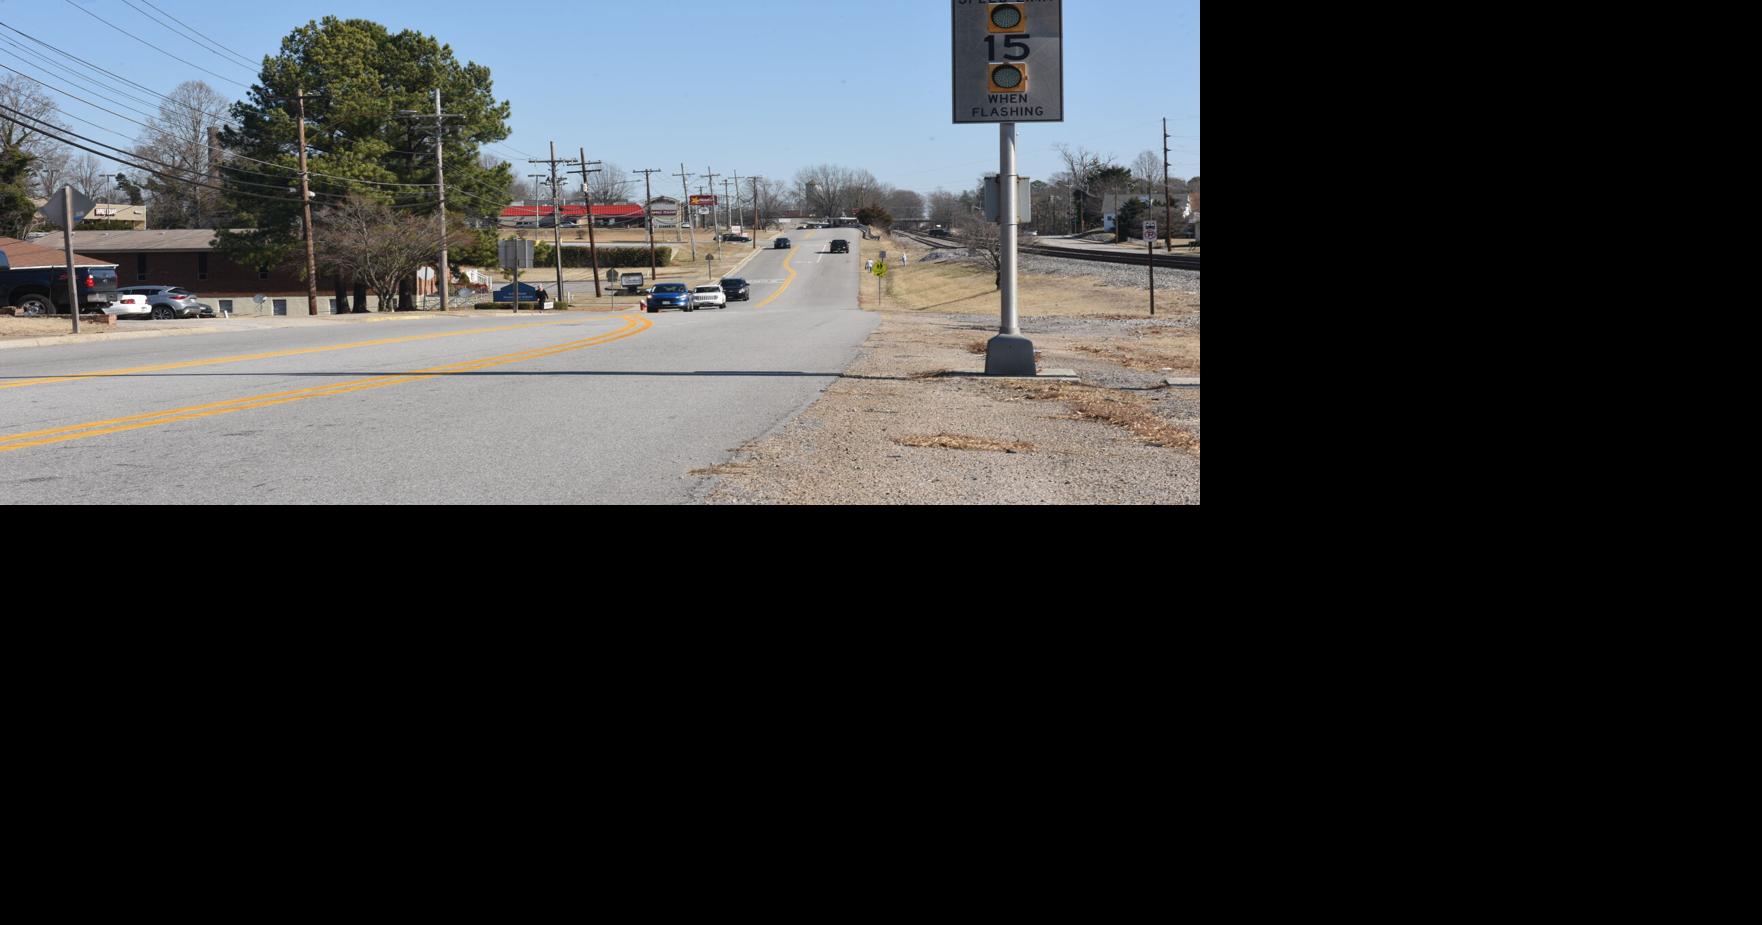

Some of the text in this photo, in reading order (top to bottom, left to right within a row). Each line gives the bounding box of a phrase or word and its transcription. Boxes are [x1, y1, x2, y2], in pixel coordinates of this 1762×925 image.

[984, 34, 1030, 61] 15
[988, 94, 1028, 104] WHEN
[972, 106, 1044, 117] FLASHING
